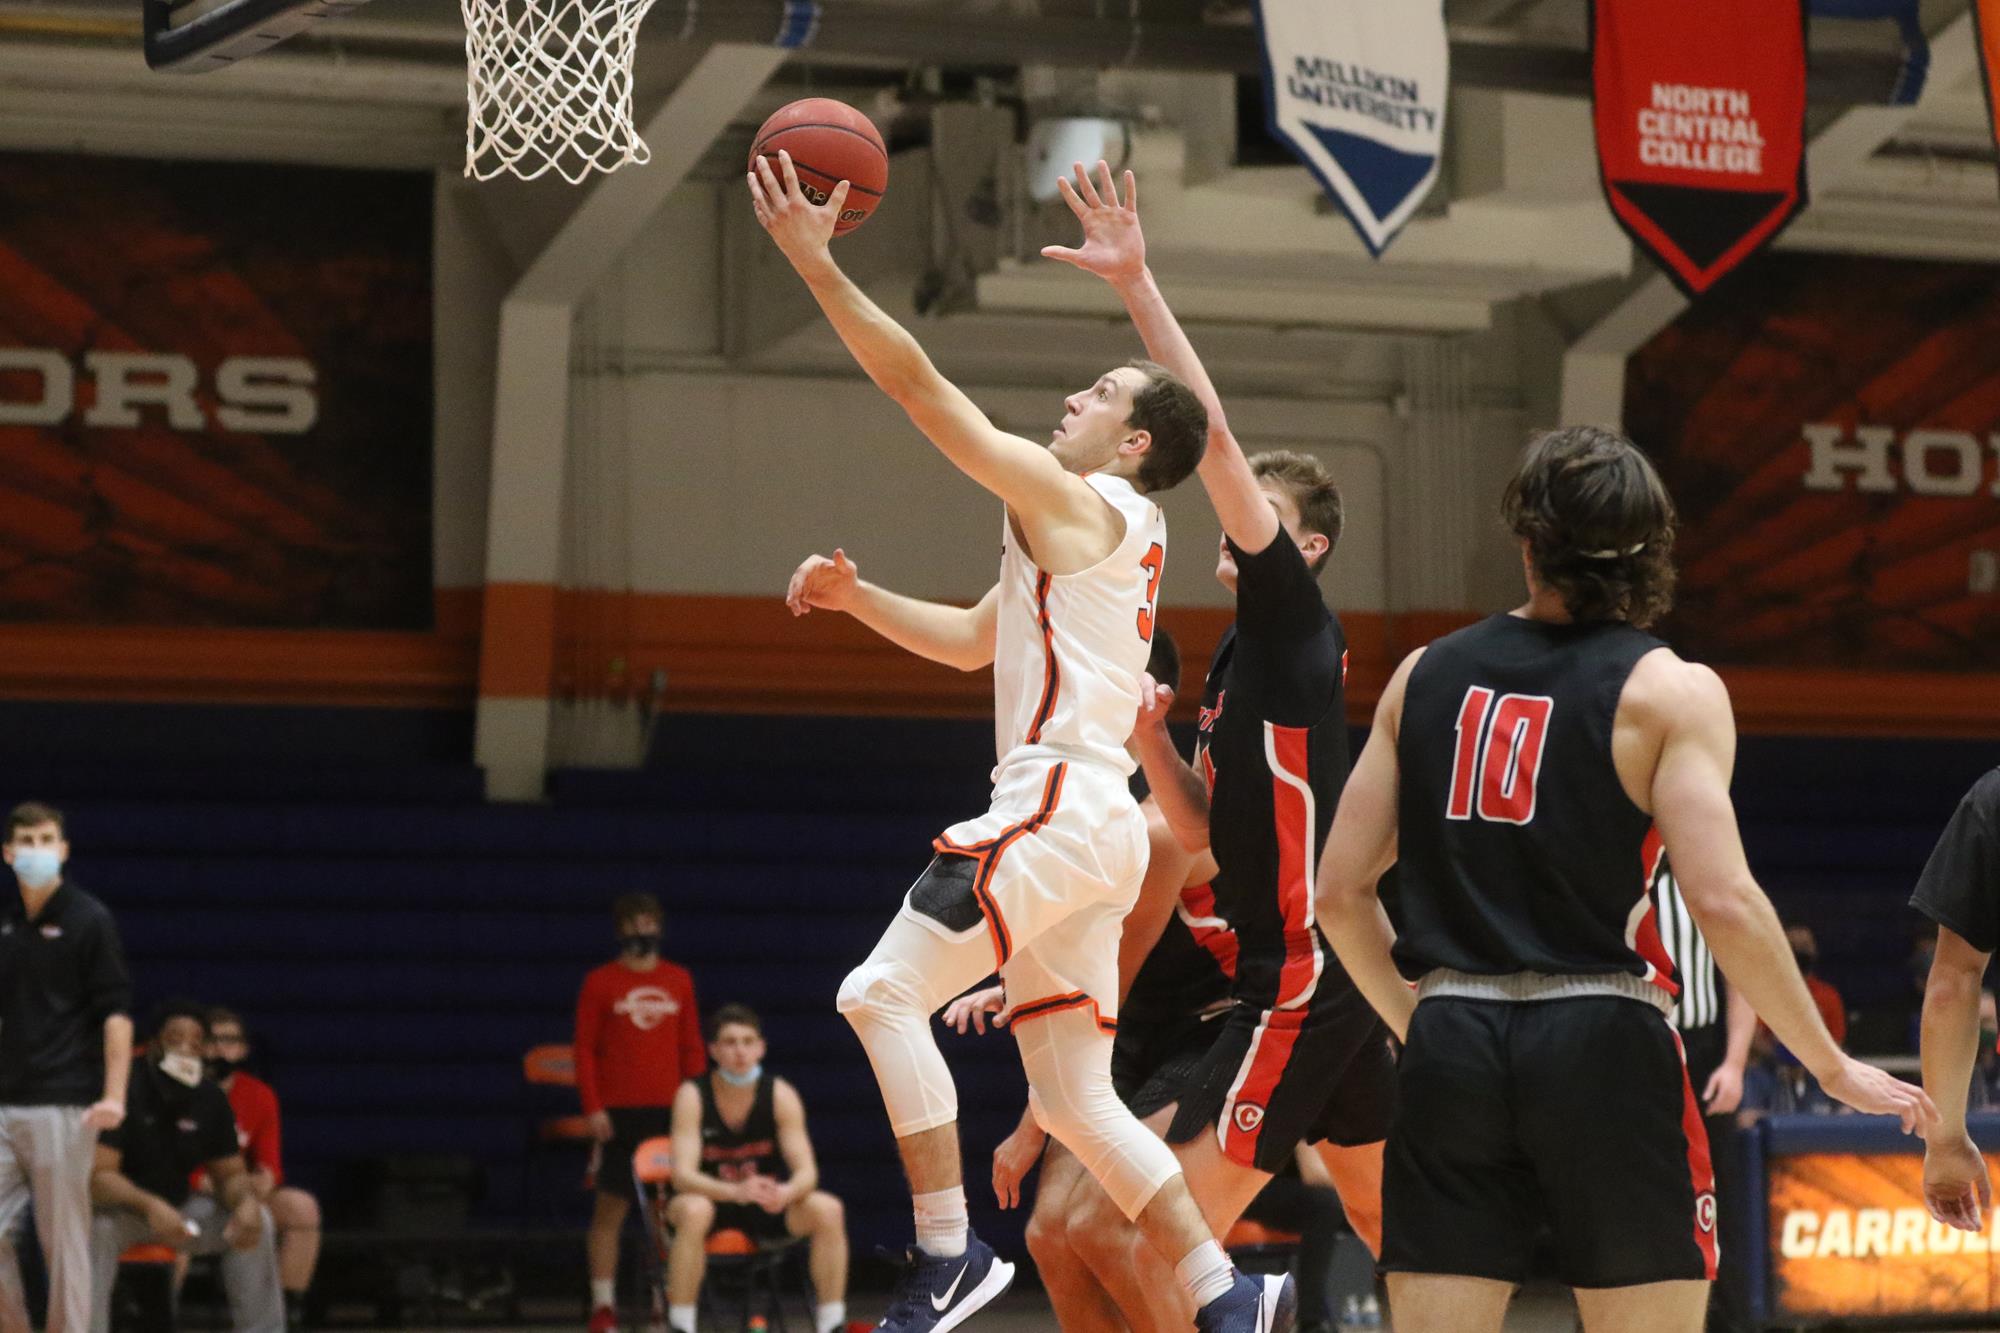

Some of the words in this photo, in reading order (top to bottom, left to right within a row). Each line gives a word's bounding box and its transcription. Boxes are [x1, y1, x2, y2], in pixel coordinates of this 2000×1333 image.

[1287, 75, 1435, 130] UNIVERSITY
[1295, 56, 1418, 102] MILLIKIN
[1651, 84, 1749, 116] NORTH
[1638, 108, 1765, 145] CENTRAL
[1640, 138, 1762, 174] COLLEGE
[1802, 423, 2000, 497] HO
[1446, 685, 1554, 826] 10
[1781, 1207, 2000, 1259] CARROL
